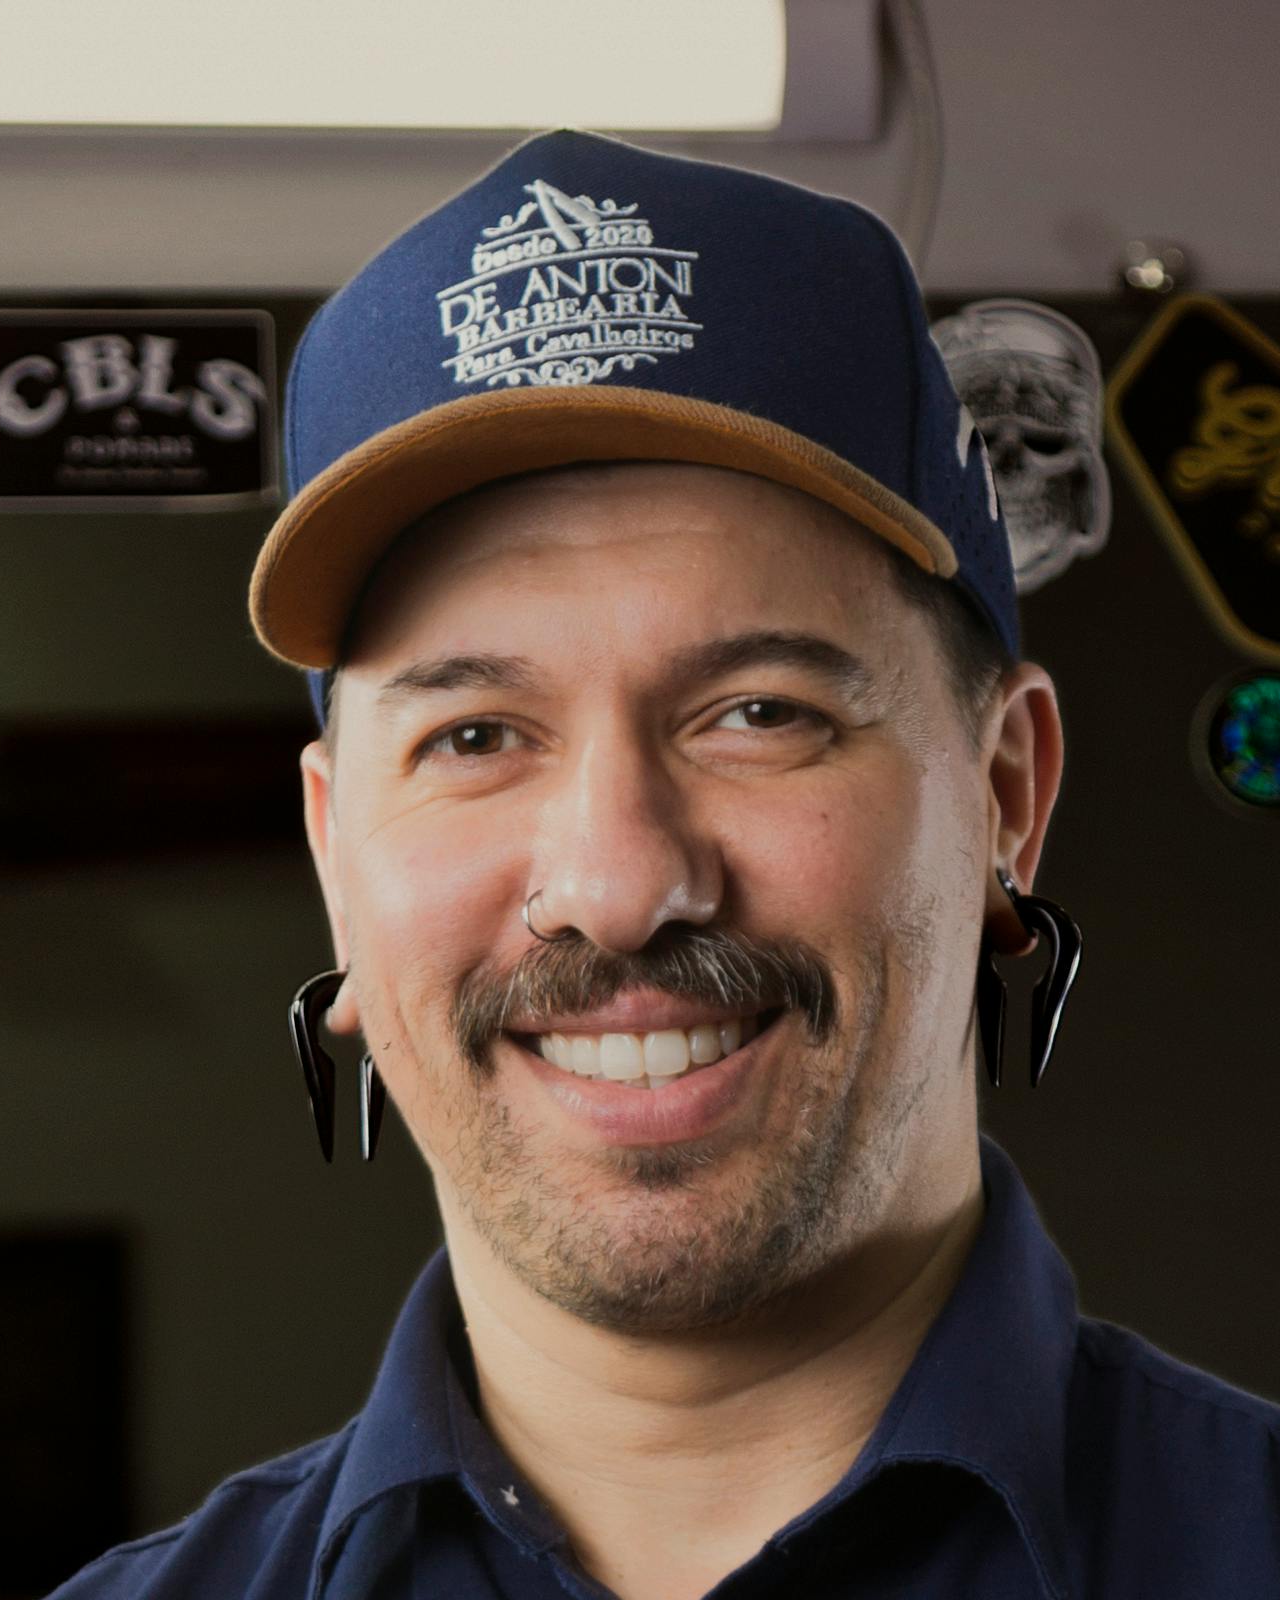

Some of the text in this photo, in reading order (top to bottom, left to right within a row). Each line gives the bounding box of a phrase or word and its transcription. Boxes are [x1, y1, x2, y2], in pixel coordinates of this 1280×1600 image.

[472, 225, 654, 275] Desde 2020
[440, 257, 694, 337] DE ANTONI
[457, 293, 689, 354] BARBEARIA
[454, 322, 695, 383] Para Cavalheiros
